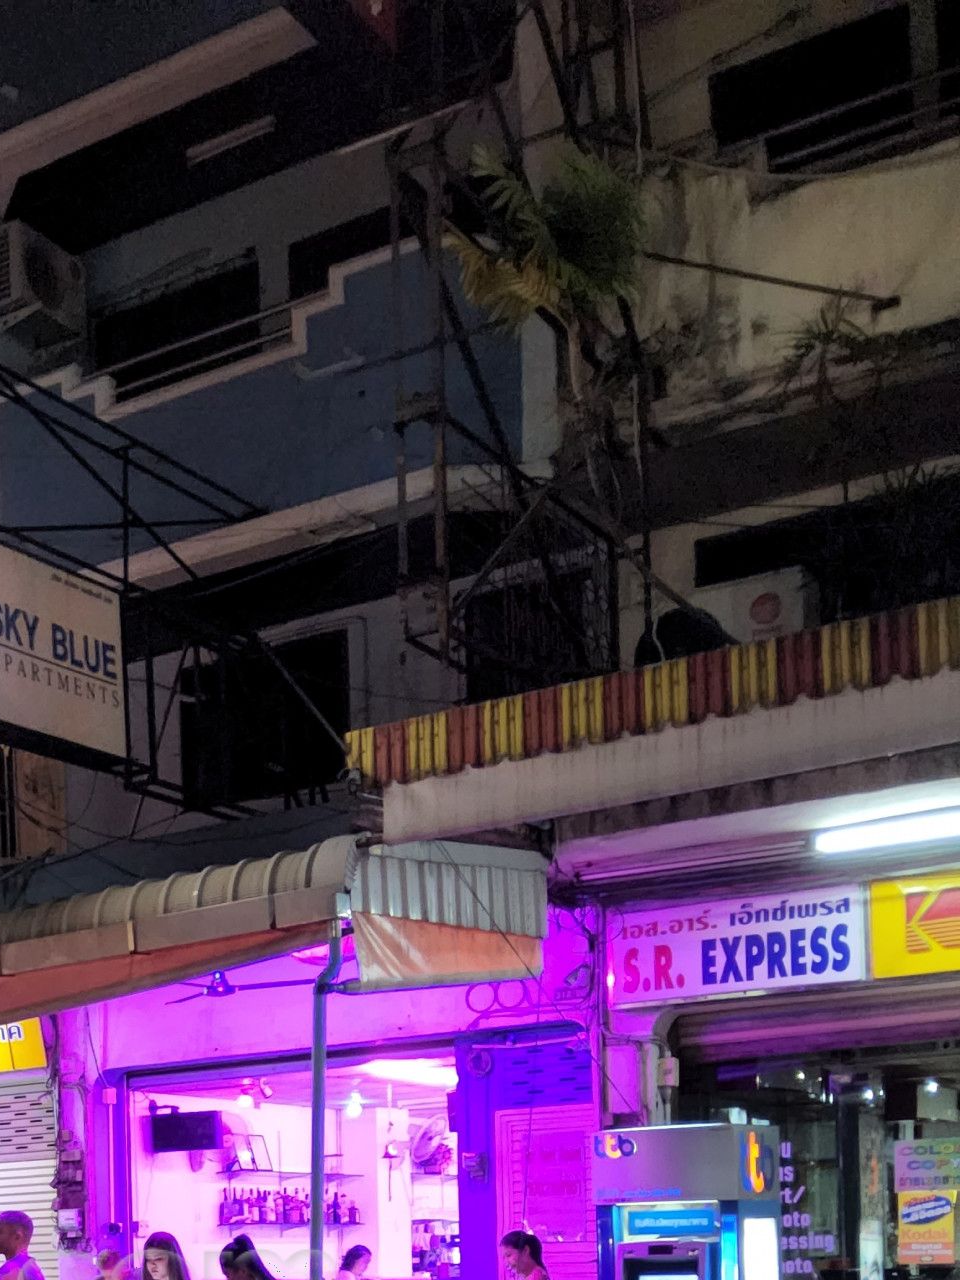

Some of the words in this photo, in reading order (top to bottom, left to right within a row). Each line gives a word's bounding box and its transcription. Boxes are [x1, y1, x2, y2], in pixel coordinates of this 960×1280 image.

[51, 622, 118, 680] BLUE
[622, 944, 686, 994] S.R.
[701, 922, 851, 986] EXPRESS
